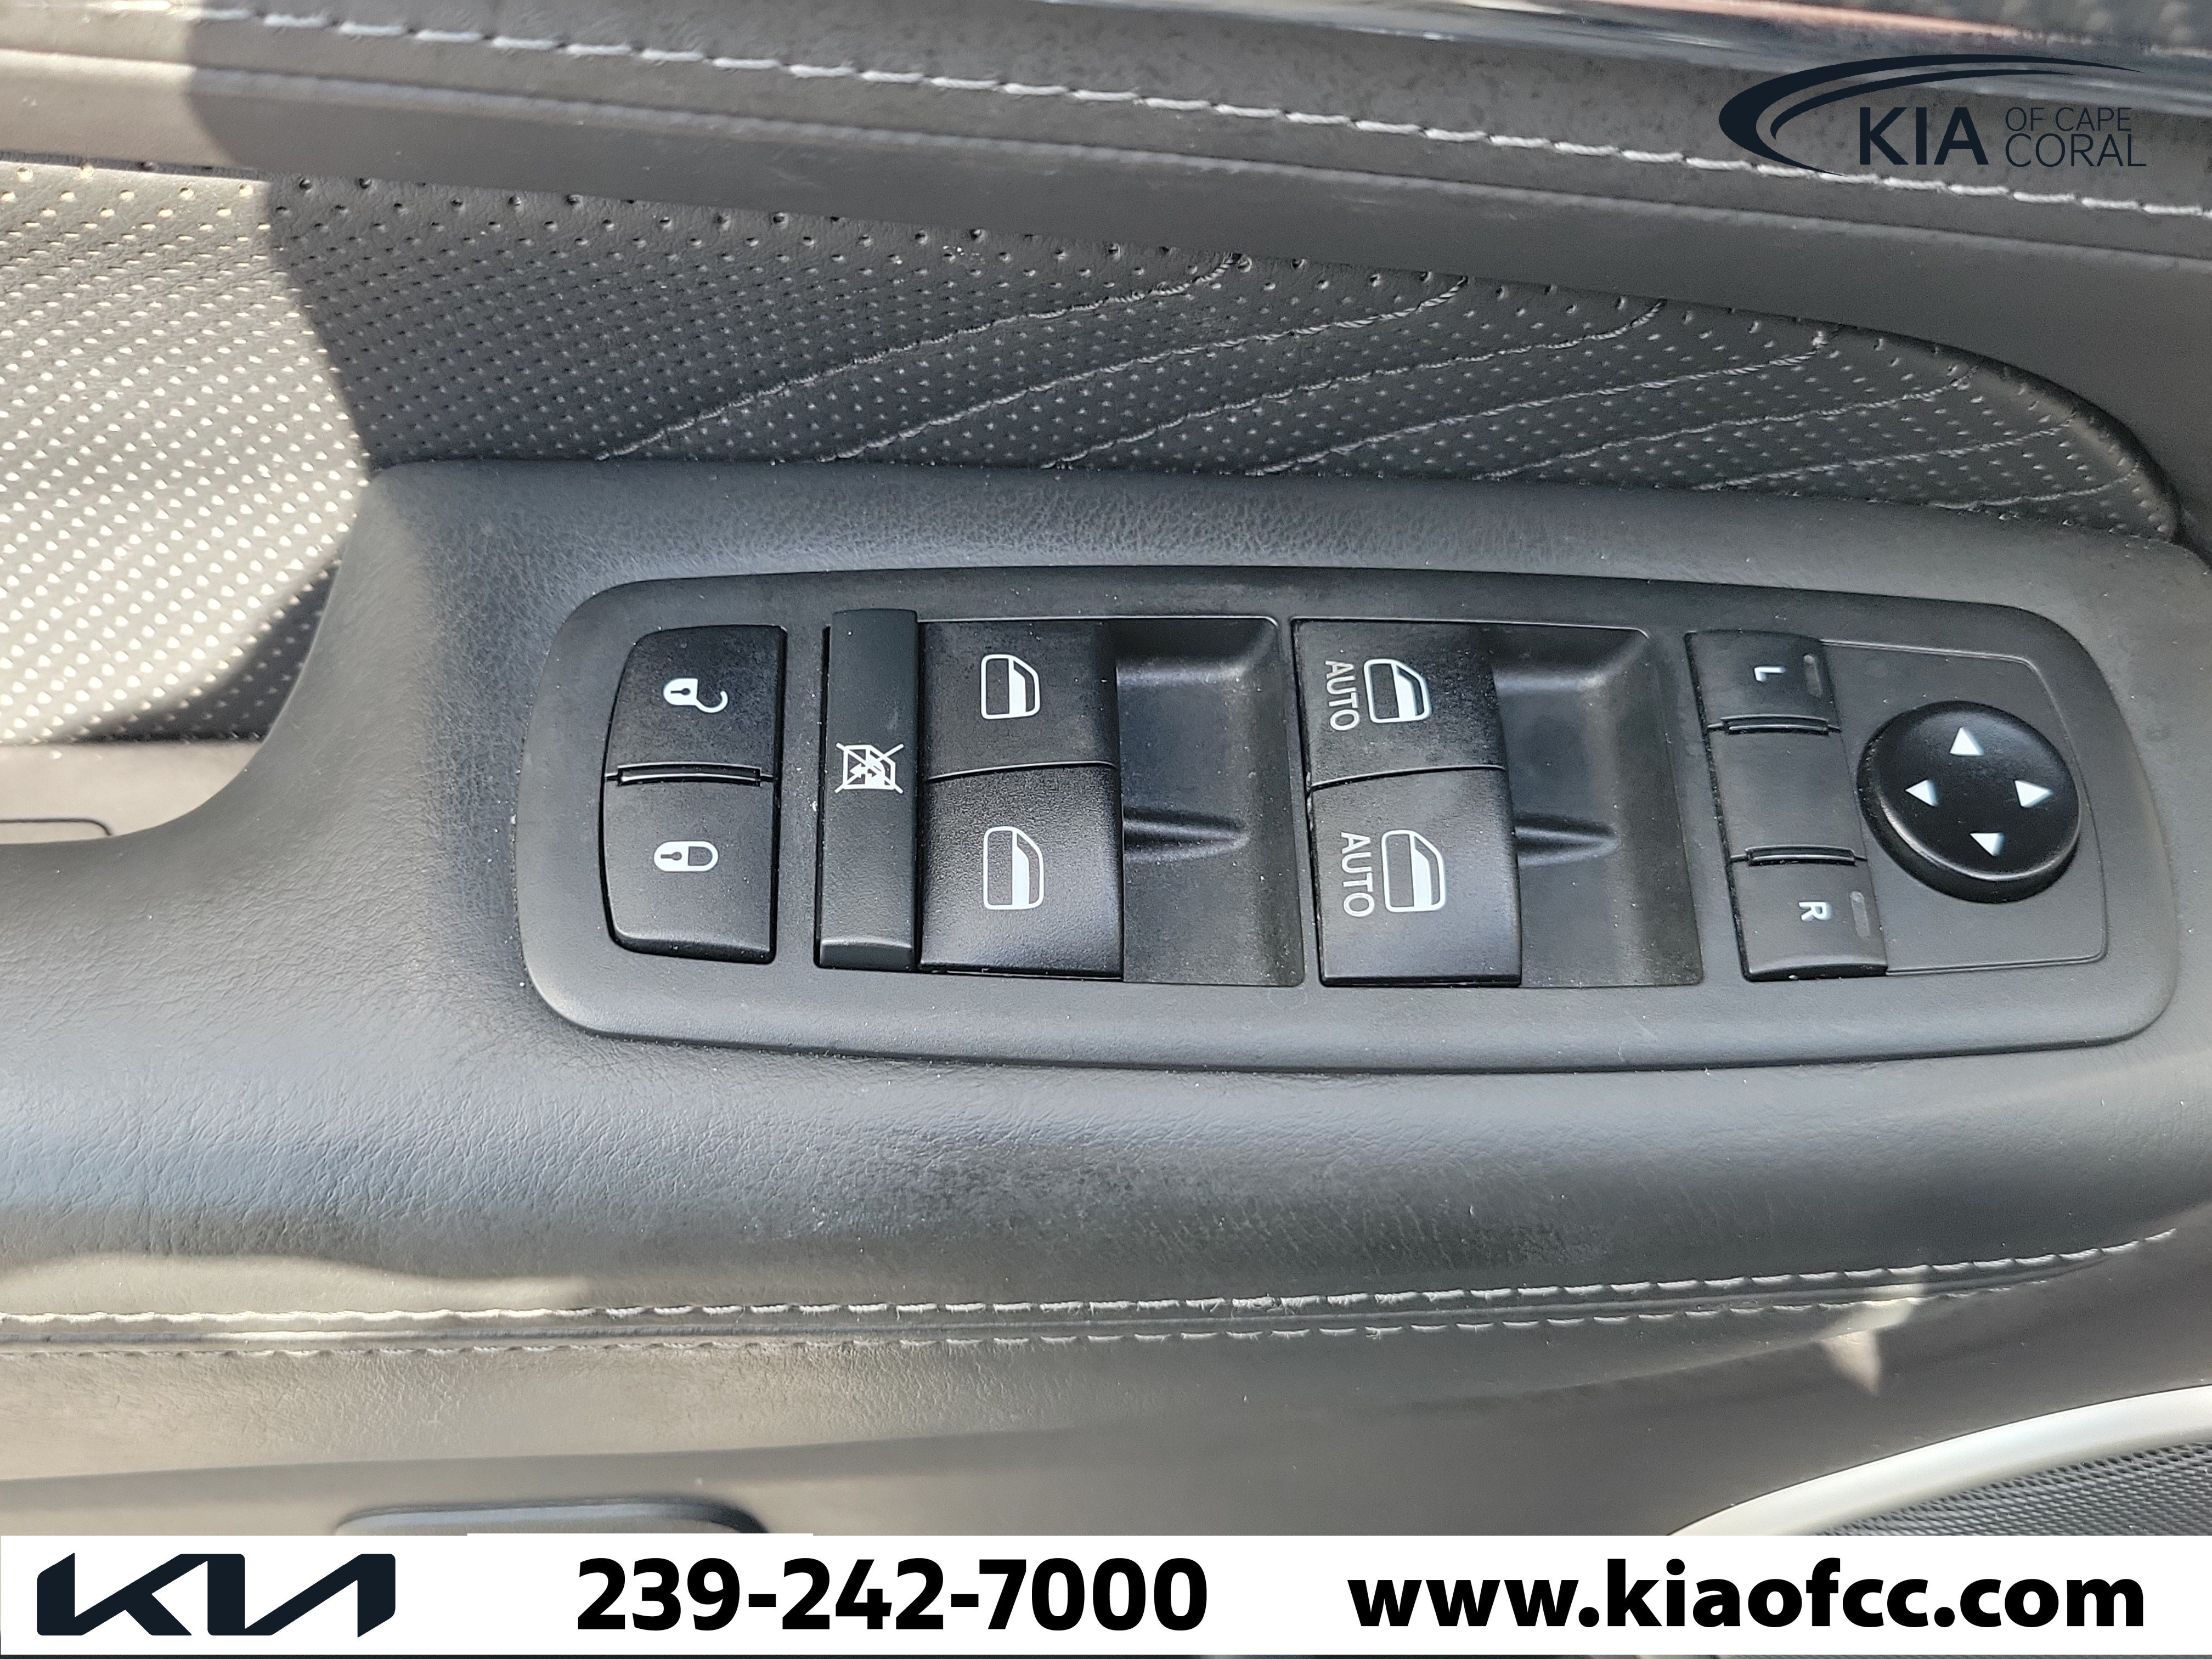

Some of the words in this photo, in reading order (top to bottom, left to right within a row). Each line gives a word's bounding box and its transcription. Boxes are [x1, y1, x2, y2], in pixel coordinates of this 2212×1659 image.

[1325, 660, 1360, 731] AUTO
[1753, 665, 1787, 682] L
[1341, 831, 1375, 918] AUTO
[1798, 901, 1832, 922] R
